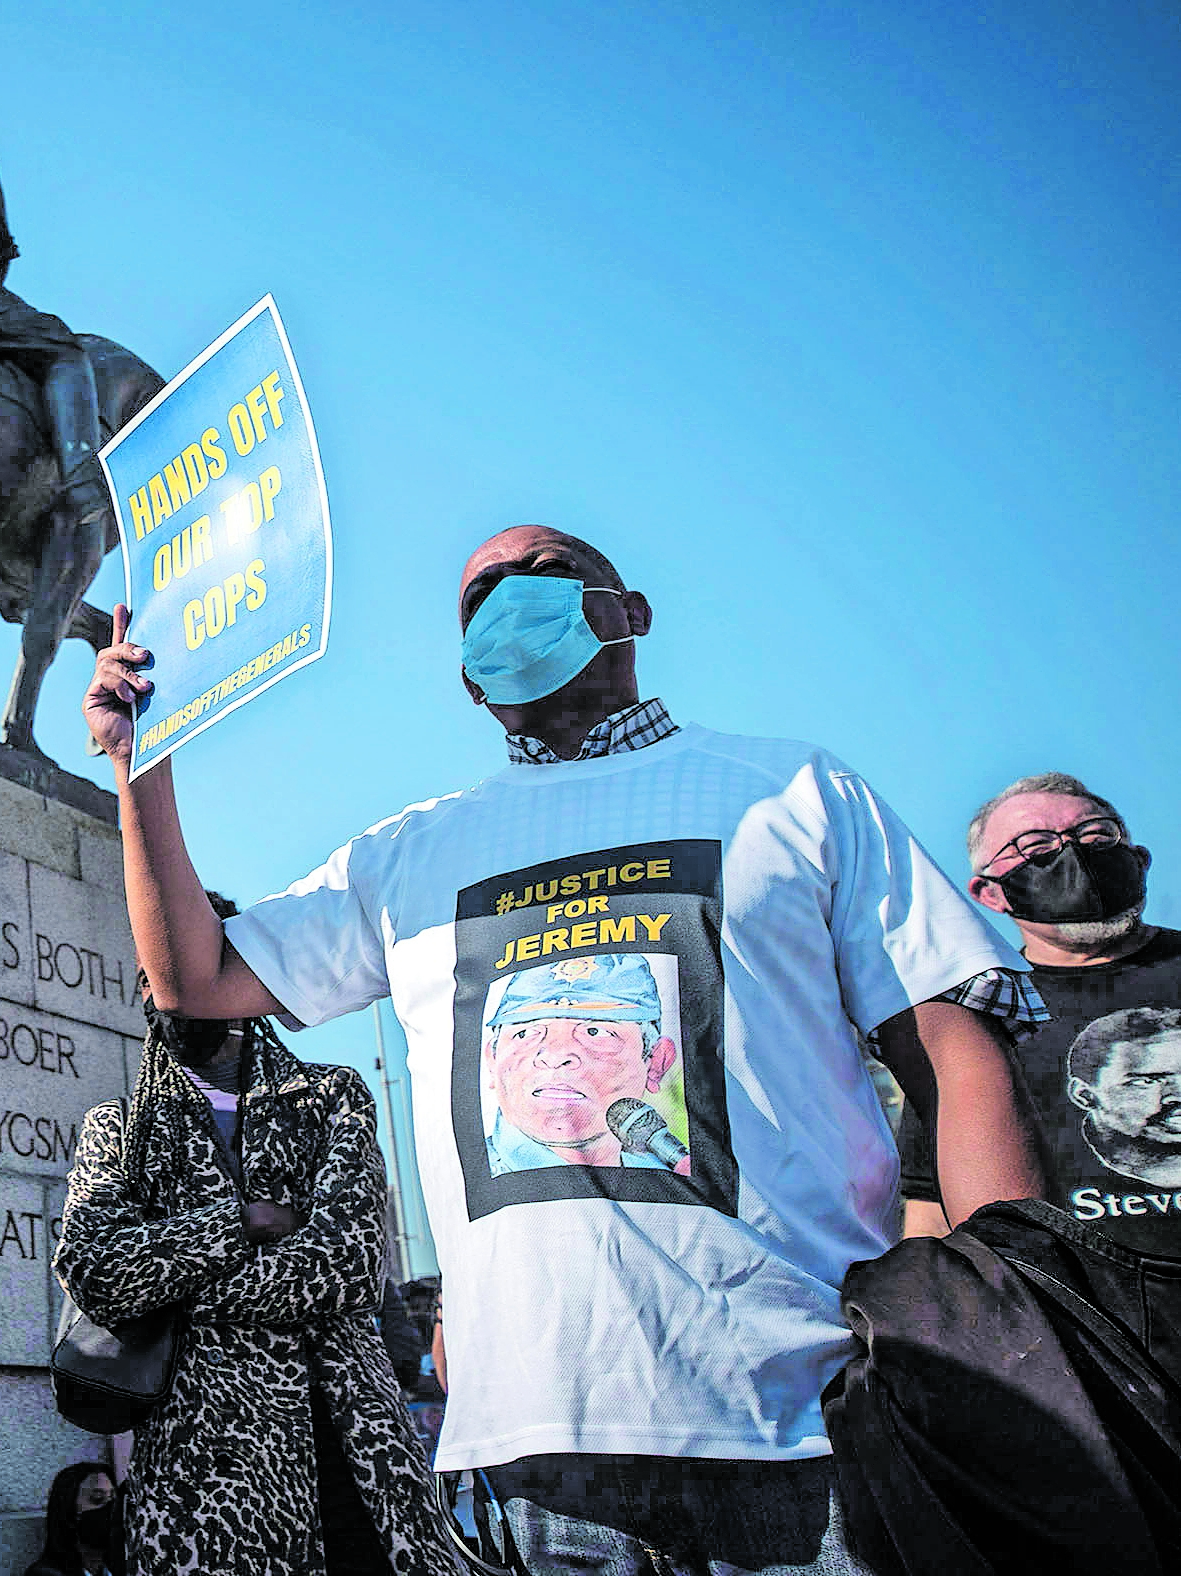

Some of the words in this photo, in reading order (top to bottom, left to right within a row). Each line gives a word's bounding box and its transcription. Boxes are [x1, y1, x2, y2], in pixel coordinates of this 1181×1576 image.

[129, 427, 228, 542] HANDS
[228, 369, 285, 458] OFF
[153, 514, 213, 594] OUR
[220, 465, 283, 548] TOP
[183, 558, 267, 652] COPS
[138, 623, 312, 756] #HANDSOFFTHEGENERALS
[496, 858, 672, 915] #JUSTICE
[546, 895, 610, 924] FOR
[494, 912, 673, 970] JEREMY
